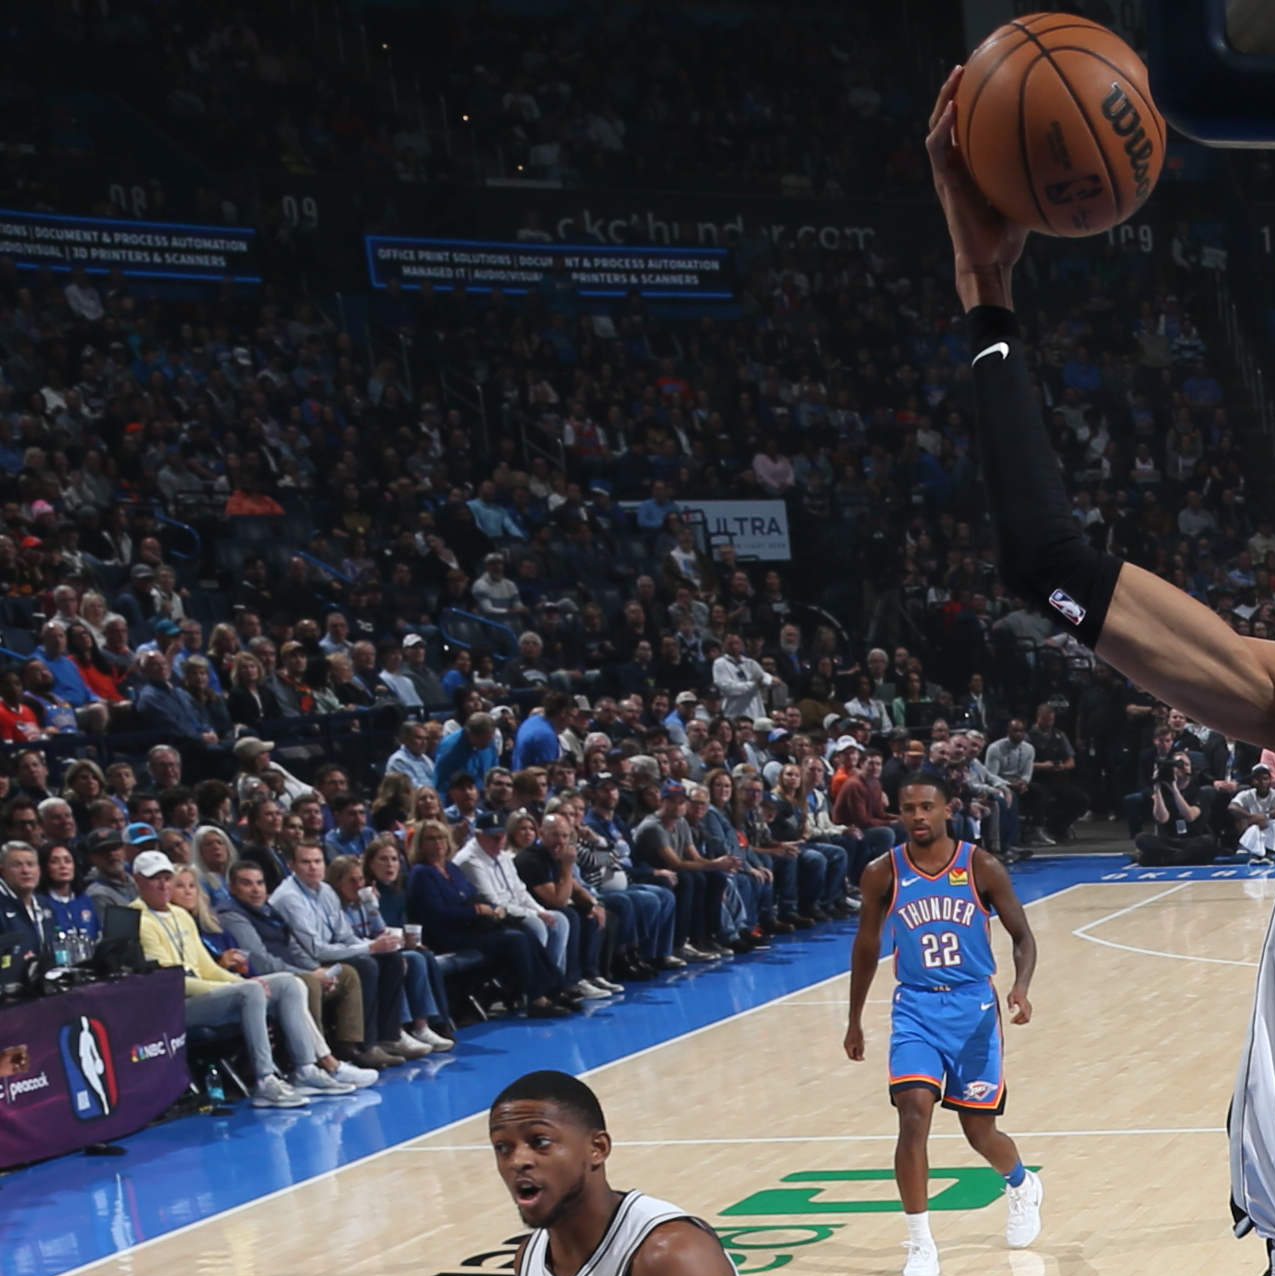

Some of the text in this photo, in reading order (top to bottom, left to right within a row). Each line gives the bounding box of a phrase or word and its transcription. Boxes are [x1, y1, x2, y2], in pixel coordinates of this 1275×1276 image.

[1101, 81, 1153, 198] Wilso
[34, 225, 98, 243] DOCUMENT
[113, 232, 169, 248] PROCESS
[171, 235, 249, 253] AUTOMATION
[90, 248, 151, 264] PRINTERS
[163, 252, 228, 268] SCANNERS
[378, 248, 415, 261] OFFICE
[417, 251, 450, 262] PRINT
[452, 253, 512, 266] SOLUTIONS
[593, 258, 646, 270] PROCESS
[647, 260, 720, 271] AUTOMATION
[402, 265, 453, 279] MANAGED
[455, 267, 466, 279] IT
[474, 269, 543, 283] AUDIO/VISUA
[571, 272, 628, 285] PRINTERS
[641, 273, 700, 286] SCANNERS
[898, 896, 977, 930] THUNDER
[921, 932, 962, 968] 22
[10, 1069, 49, 1101] peacock
